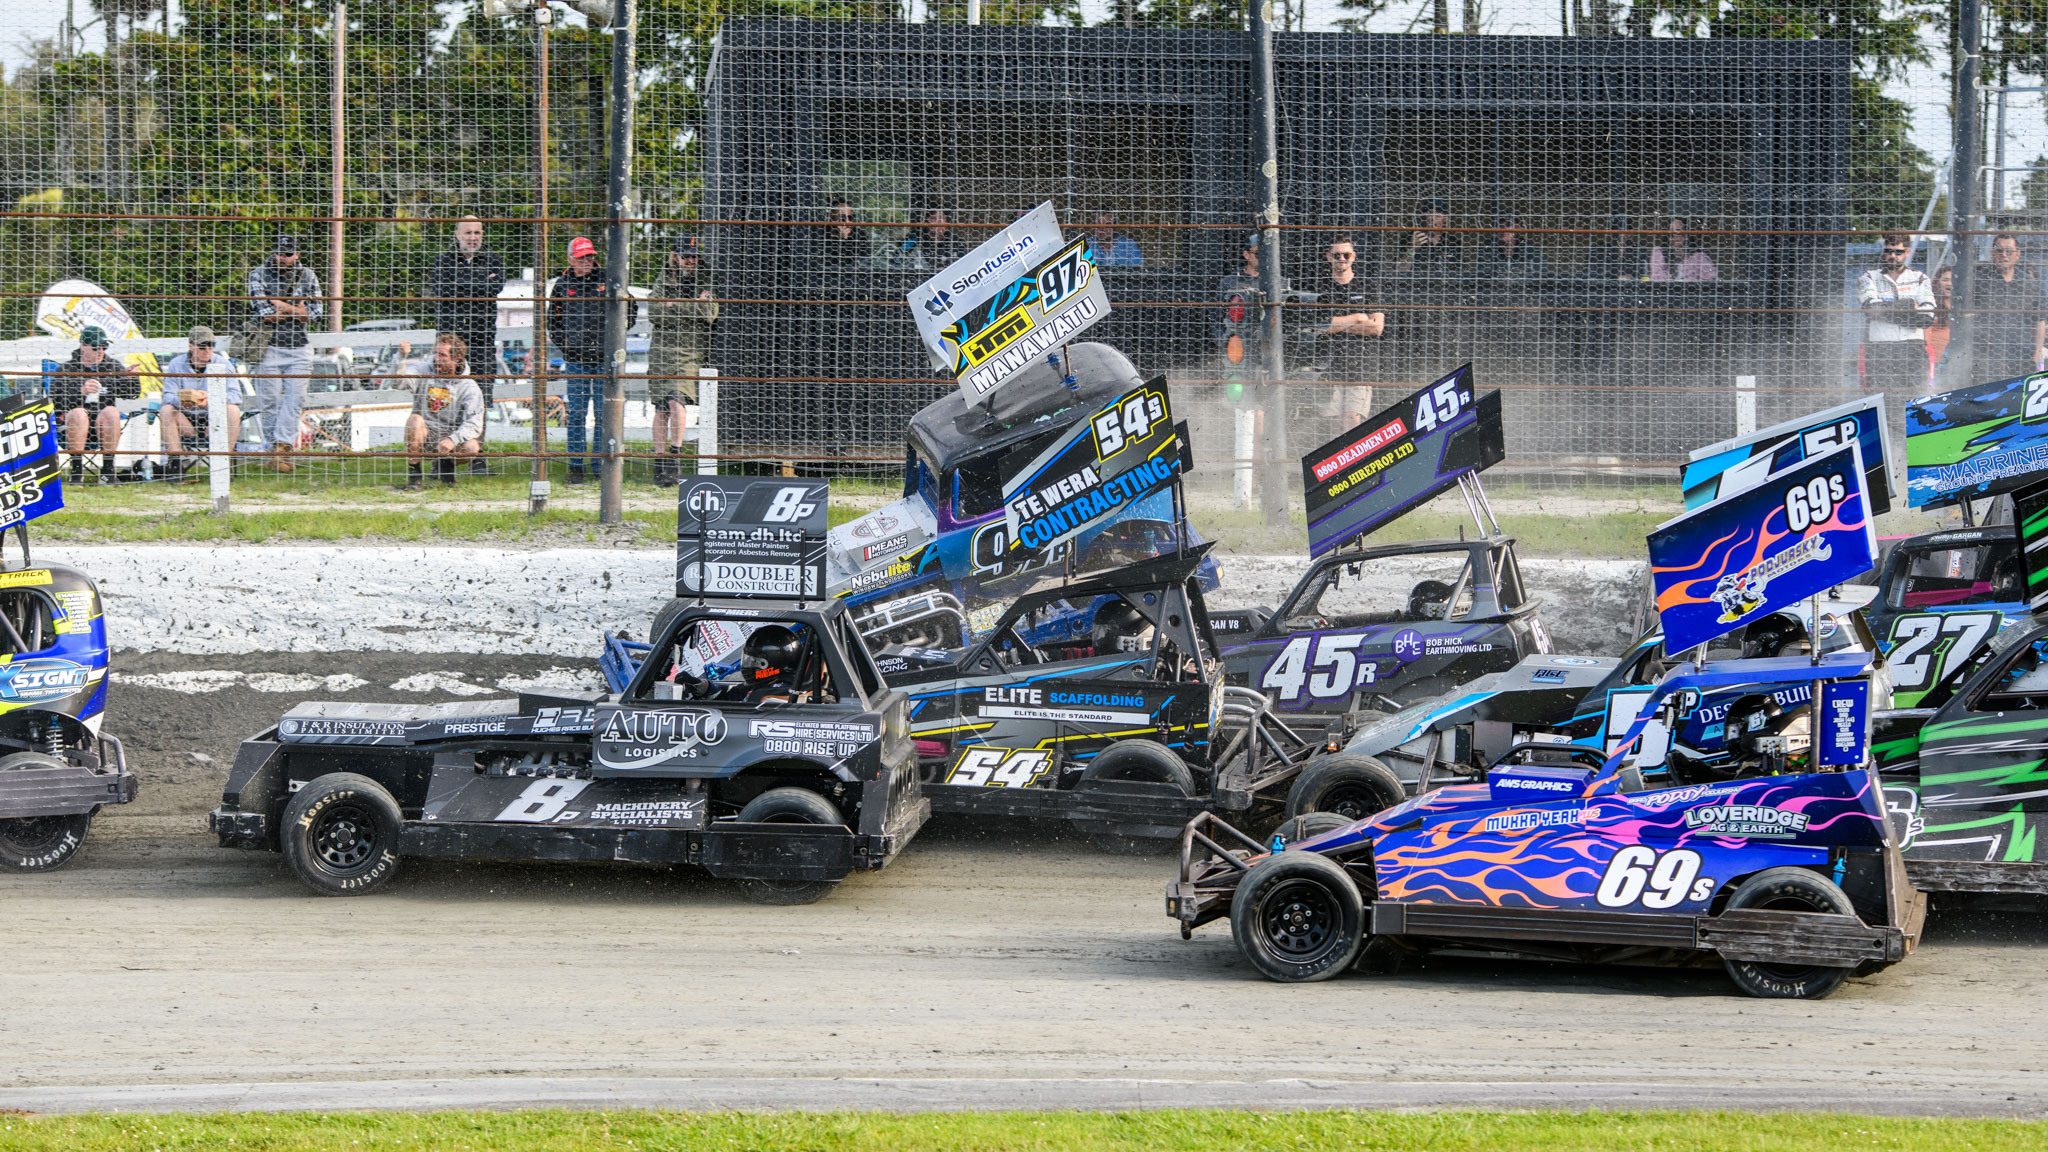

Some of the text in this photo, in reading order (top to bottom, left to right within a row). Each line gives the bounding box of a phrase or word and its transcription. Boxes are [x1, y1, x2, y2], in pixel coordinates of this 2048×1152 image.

[952, 235, 1035, 295] Signfusion
[970, 296, 1098, 395] MANAWATU
[1317, 422, 1402, 478] 0800 DEADMEN LTD
[1328, 442, 1414, 497] 0800 HIREPROP LTD
[1015, 467, 1099, 520] TE WERA
[1020, 456, 1172, 549] CONTRACTING
[699, 529, 743, 540] eam
[872, 534, 907, 553] MEANS
[704, 540, 735, 548] egistered
[737, 541, 761, 549] Master
[1750, 536, 1818, 580] PODJURSKY
[718, 566, 795, 581] DOUBLE
[852, 562, 911, 588] Nebulite
[716, 580, 814, 592] CONSTRUCTION
[1210, 619, 1239, 630] SAN V8
[1425, 644, 1493, 656] EARTHMOVING LTD
[1426, 637, 1463, 646] BOB HICK
[985, 687, 1144, 708] ELITE SCAFFOLDING
[321, 721, 332, 729] R
[334, 721, 405, 730] INSULATION
[1068, 713, 1112, 721] STANDARD
[444, 722, 506, 734] PRESTIGE
[600, 710, 728, 746] AUTO
[750, 720, 796, 738] RS
[857, 731, 872, 741] LTD
[766, 740, 857, 756] 0800 RISE UP
[1495, 778, 1573, 791] AWS GRAPHICS
[1646, 786, 1706, 806] PODJY
[298, 790, 355, 830] Hoosier
[590, 810, 693, 820] SPECIALISTS
[596, 801, 690, 811] MACHINERY
[1541, 809, 1579, 824] YEAH
[1686, 806, 1808, 830] LOVERIDGE
[1709, 823, 1784, 833] AG & EARTH
[20, 831, 78, 867] Hoosier
[341, 849, 396, 889] Hoosier
[1741, 962, 1806, 998] Hoosier
